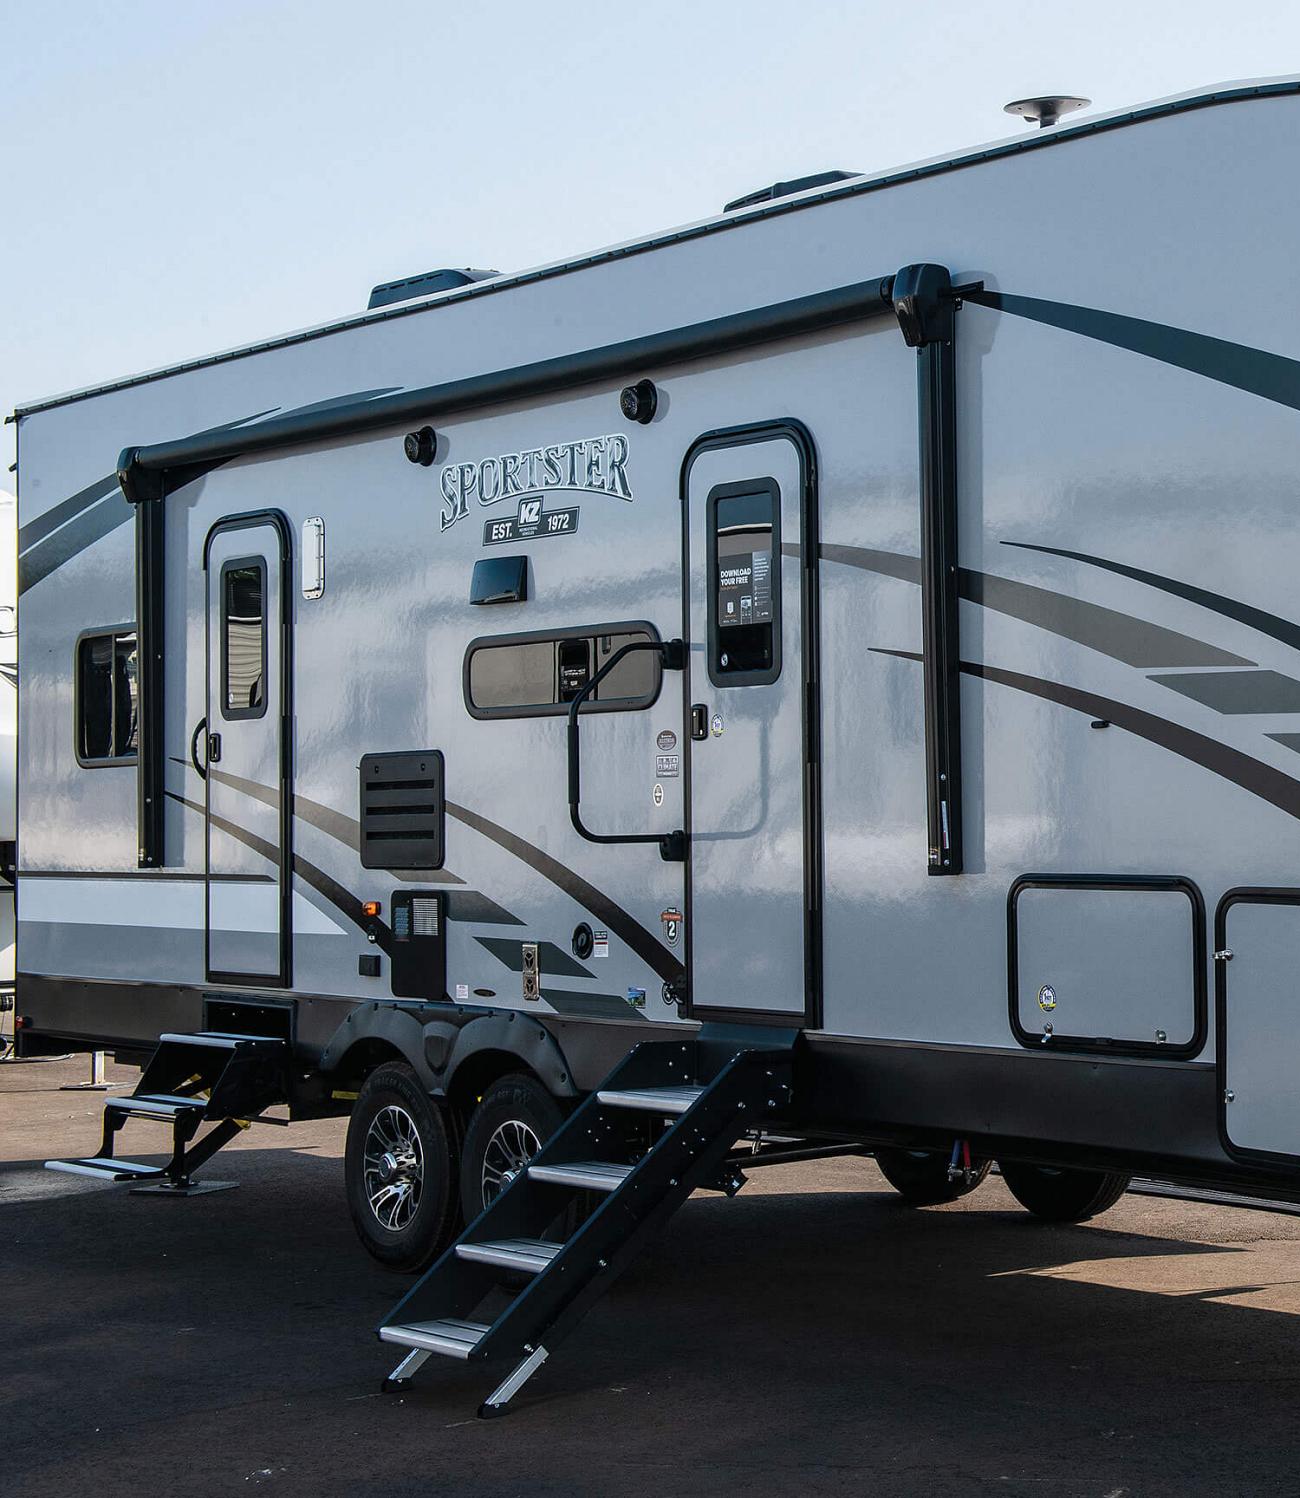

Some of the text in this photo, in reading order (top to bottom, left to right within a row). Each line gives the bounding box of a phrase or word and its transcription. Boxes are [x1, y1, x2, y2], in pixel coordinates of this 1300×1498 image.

[440, 434, 633, 532] SPORTSTER
[520, 501, 541, 524] KZ
[492, 513, 569, 540] EST. 1972
[720, 568, 751, 578] DOWNLOAD
[721, 576, 748, 586] YOUR FREE
[668, 921, 675, 936] 2
